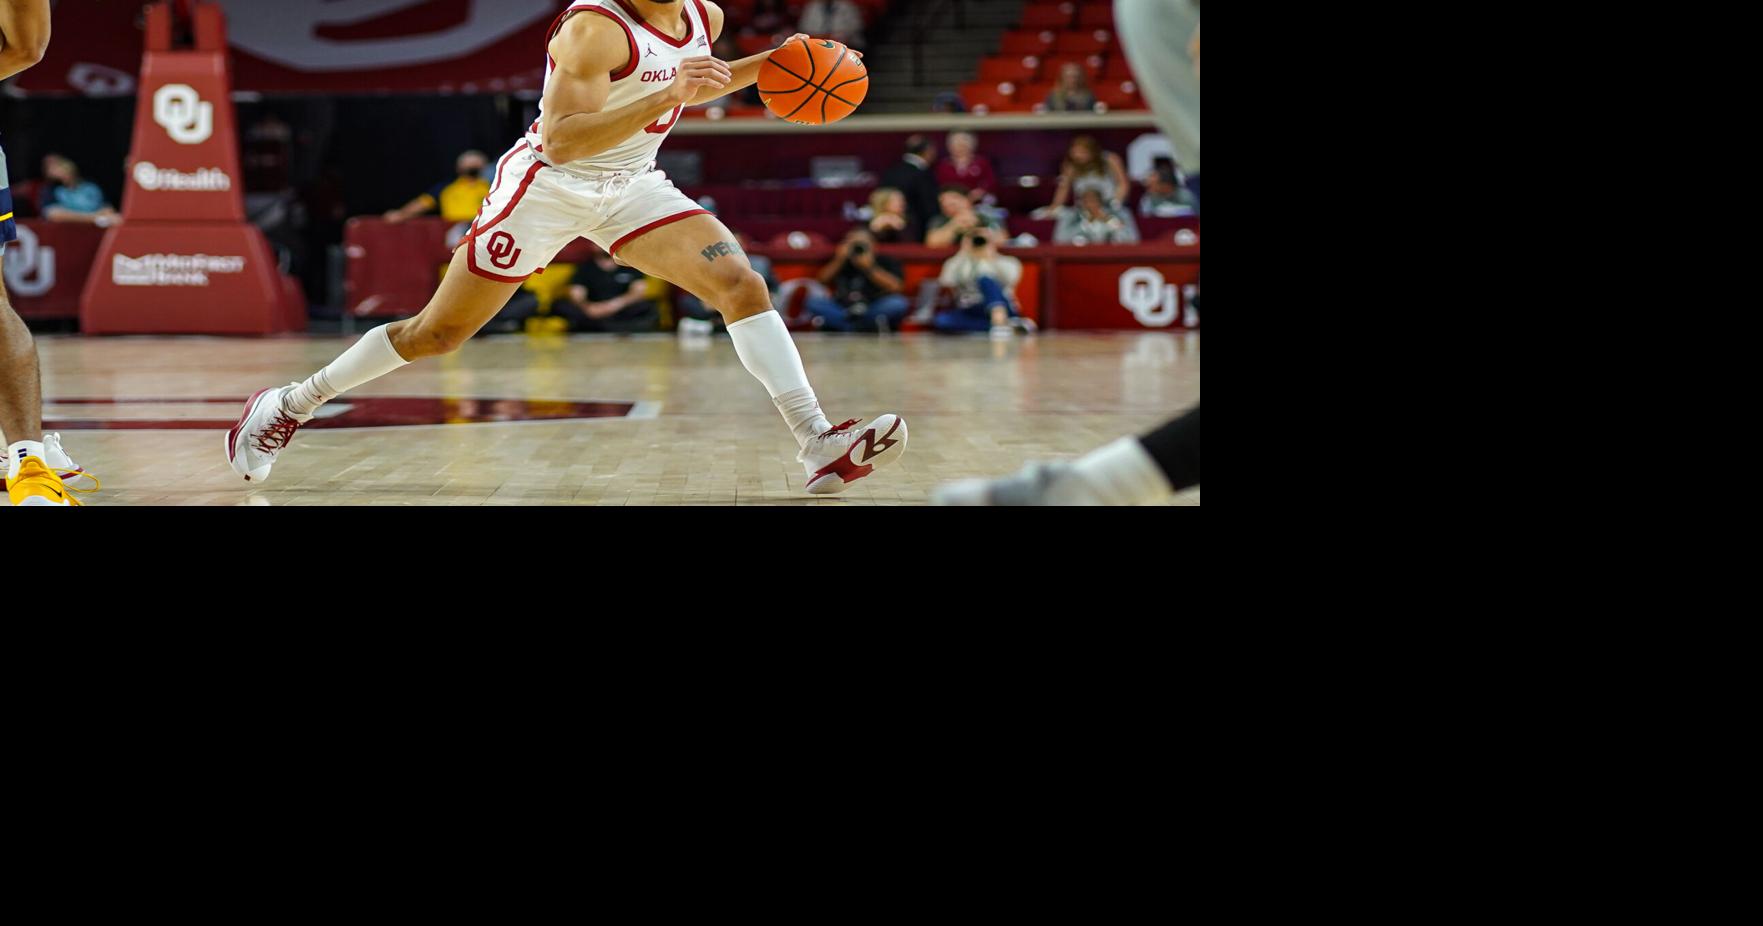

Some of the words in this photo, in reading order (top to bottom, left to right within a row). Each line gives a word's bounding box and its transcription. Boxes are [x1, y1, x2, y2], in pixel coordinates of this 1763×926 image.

[640, 66, 677, 82] OKLA
[154, 84, 213, 144] OU
[487, 231, 521, 269] OU
[1119, 266, 1178, 328] OU
